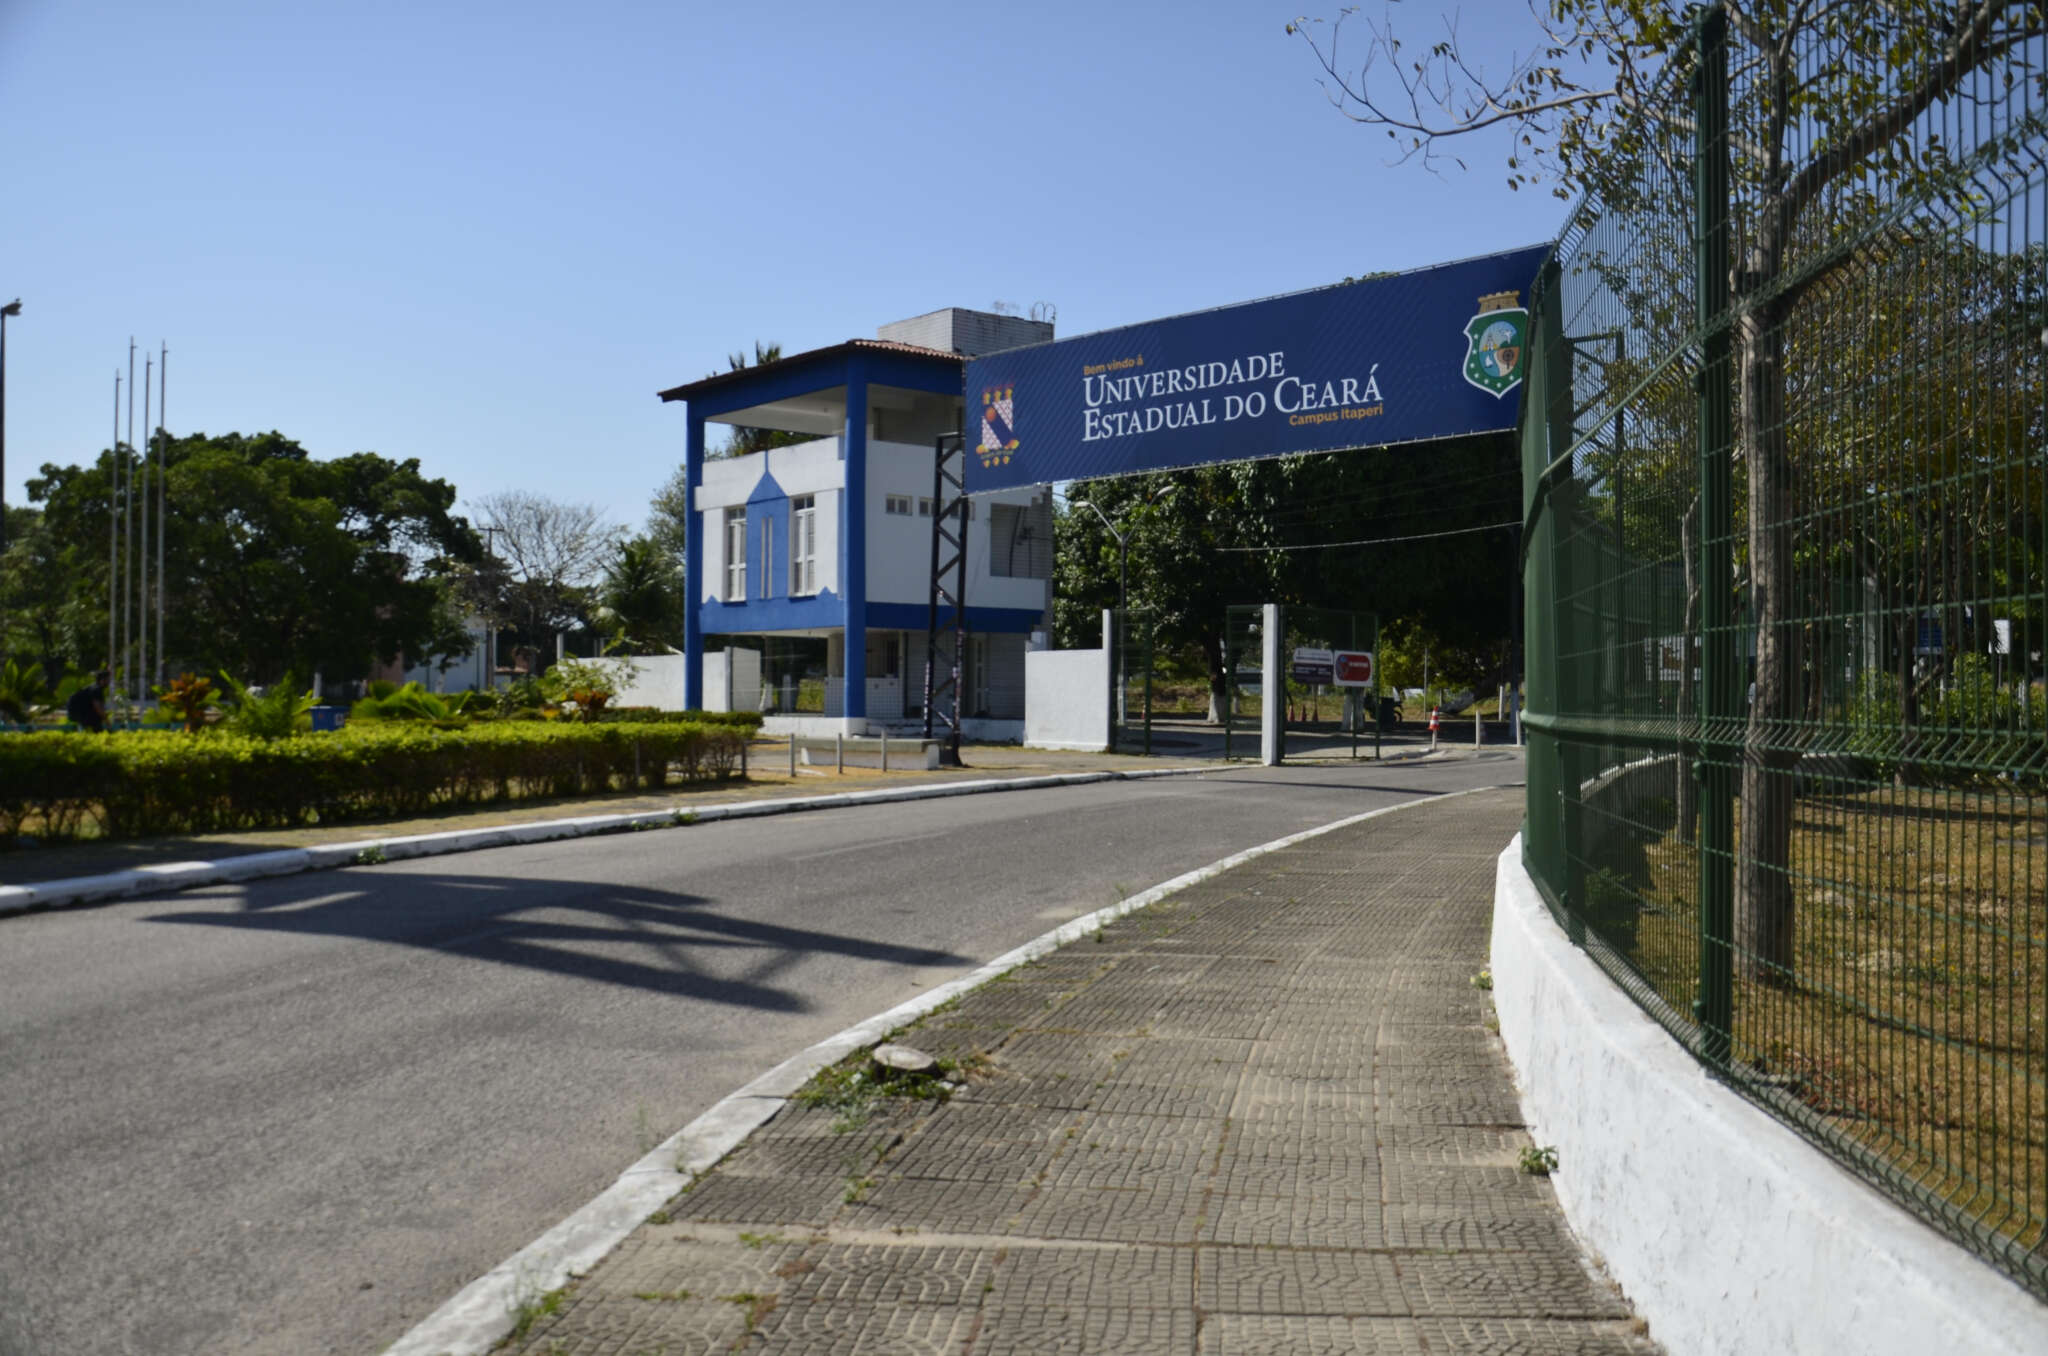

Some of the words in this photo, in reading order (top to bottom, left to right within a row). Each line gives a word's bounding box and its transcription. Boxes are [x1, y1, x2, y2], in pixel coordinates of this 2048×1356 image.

[1082, 351, 1286, 408] UNIVERSIDADE
[1082, 399, 1217, 442] ESTADUAL
[1224, 391, 1267, 421] DO
[1273, 363, 1384, 414] CEARÁ
[1289, 409, 1339, 426] Campus
[1341, 402, 1384, 420] Itaperi
